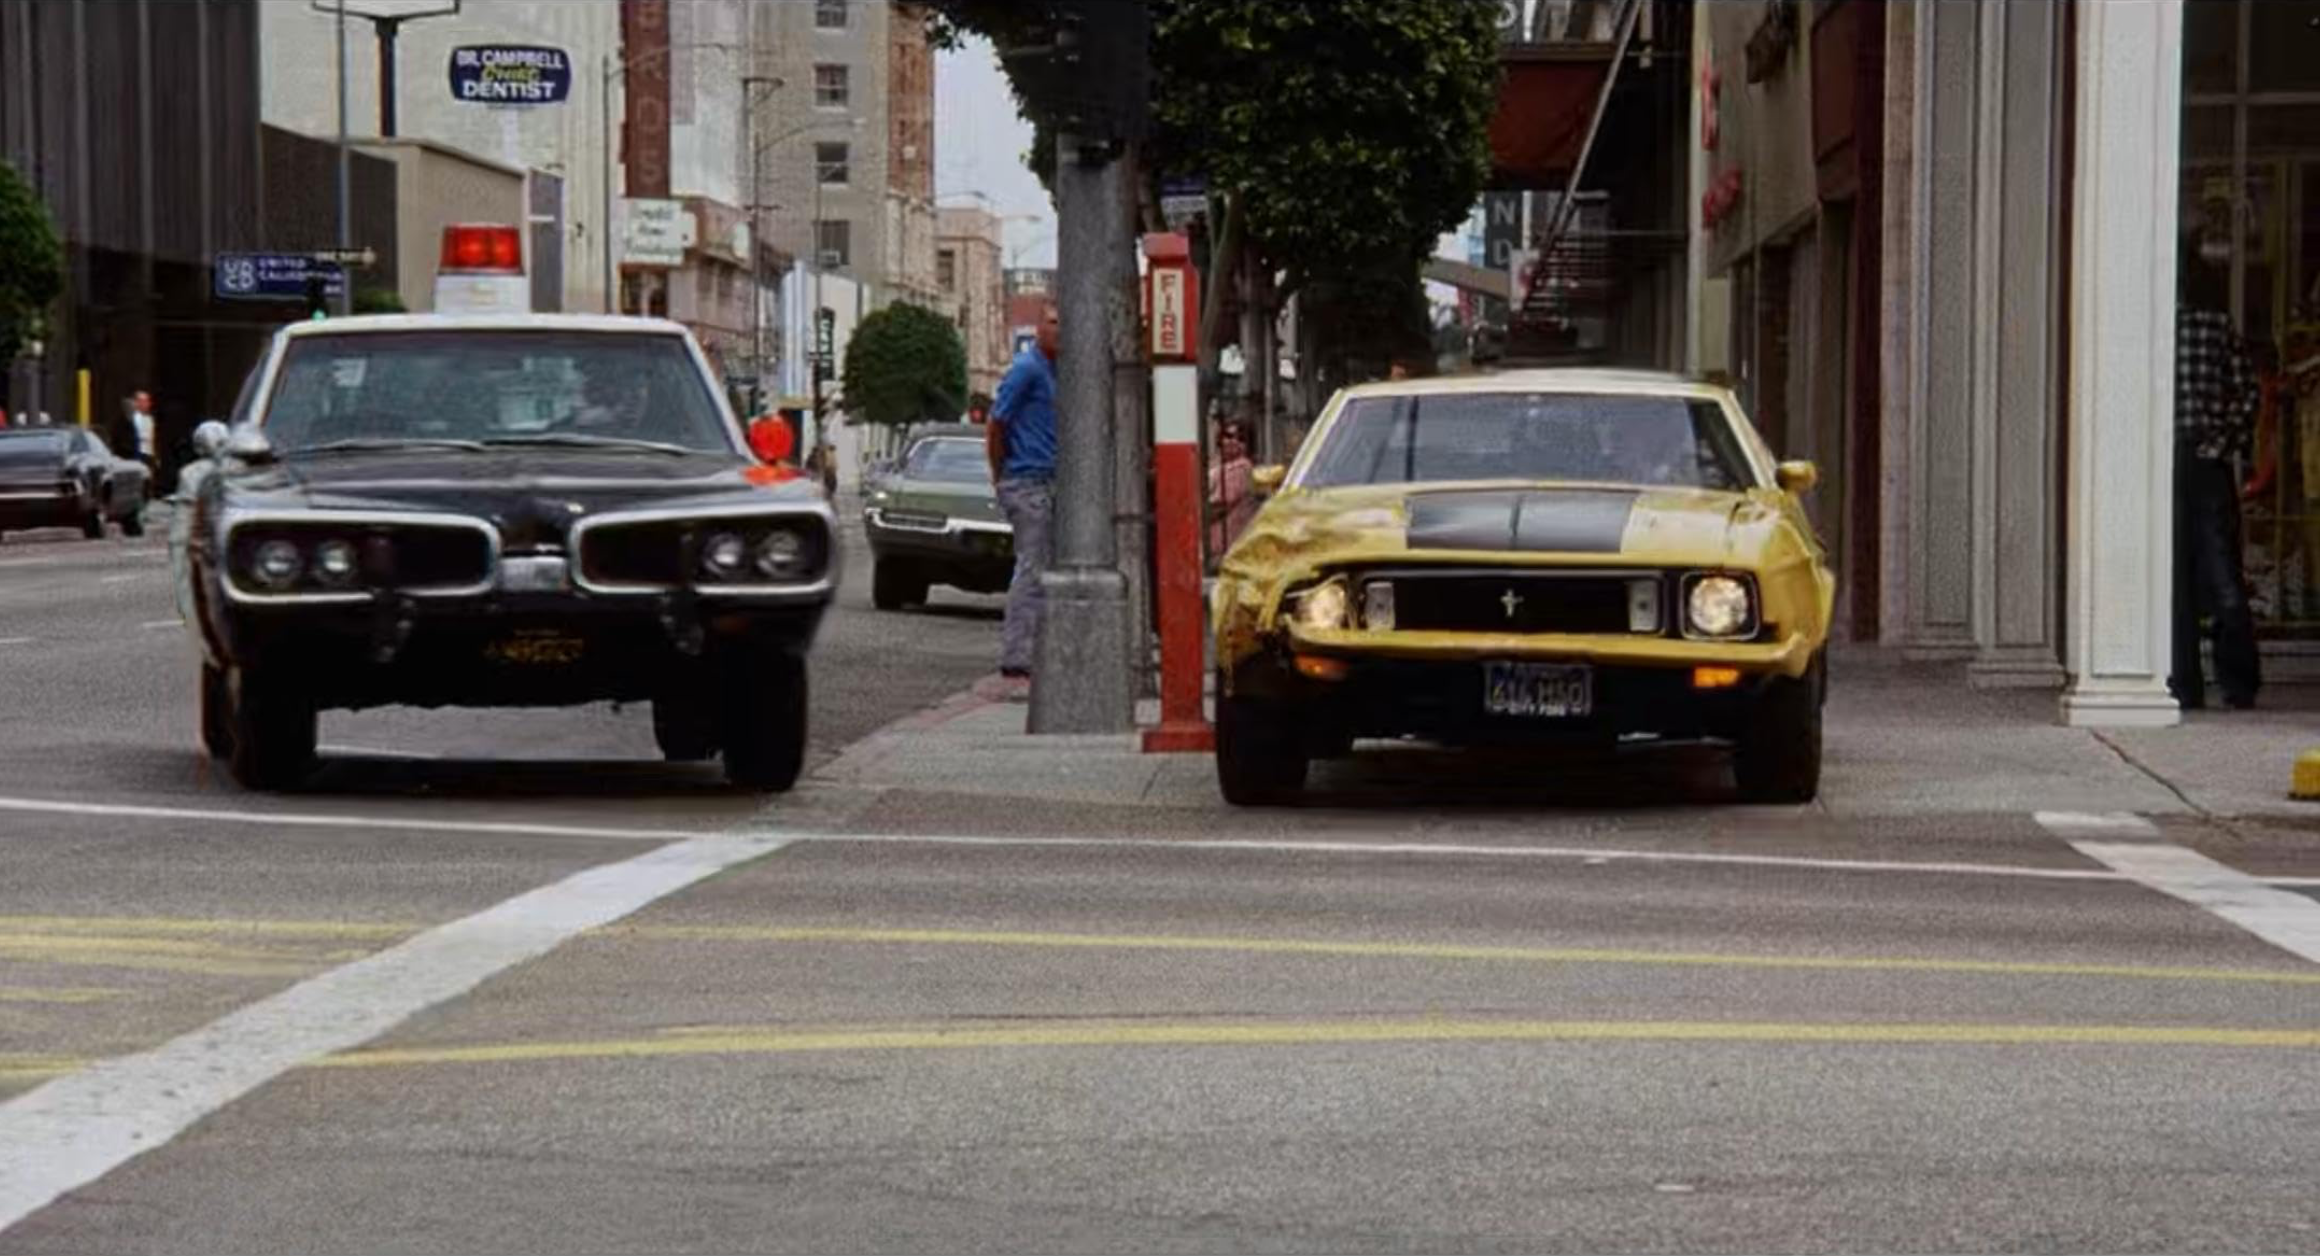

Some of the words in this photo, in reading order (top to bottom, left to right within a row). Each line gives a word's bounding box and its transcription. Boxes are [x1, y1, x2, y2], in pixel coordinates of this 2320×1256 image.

[482, 50, 564, 69] CAMPBELL
[462, 81, 556, 98] DENTIST
[259, 258, 306, 268] UNITED
[1160, 274, 1177, 349] FIRE
